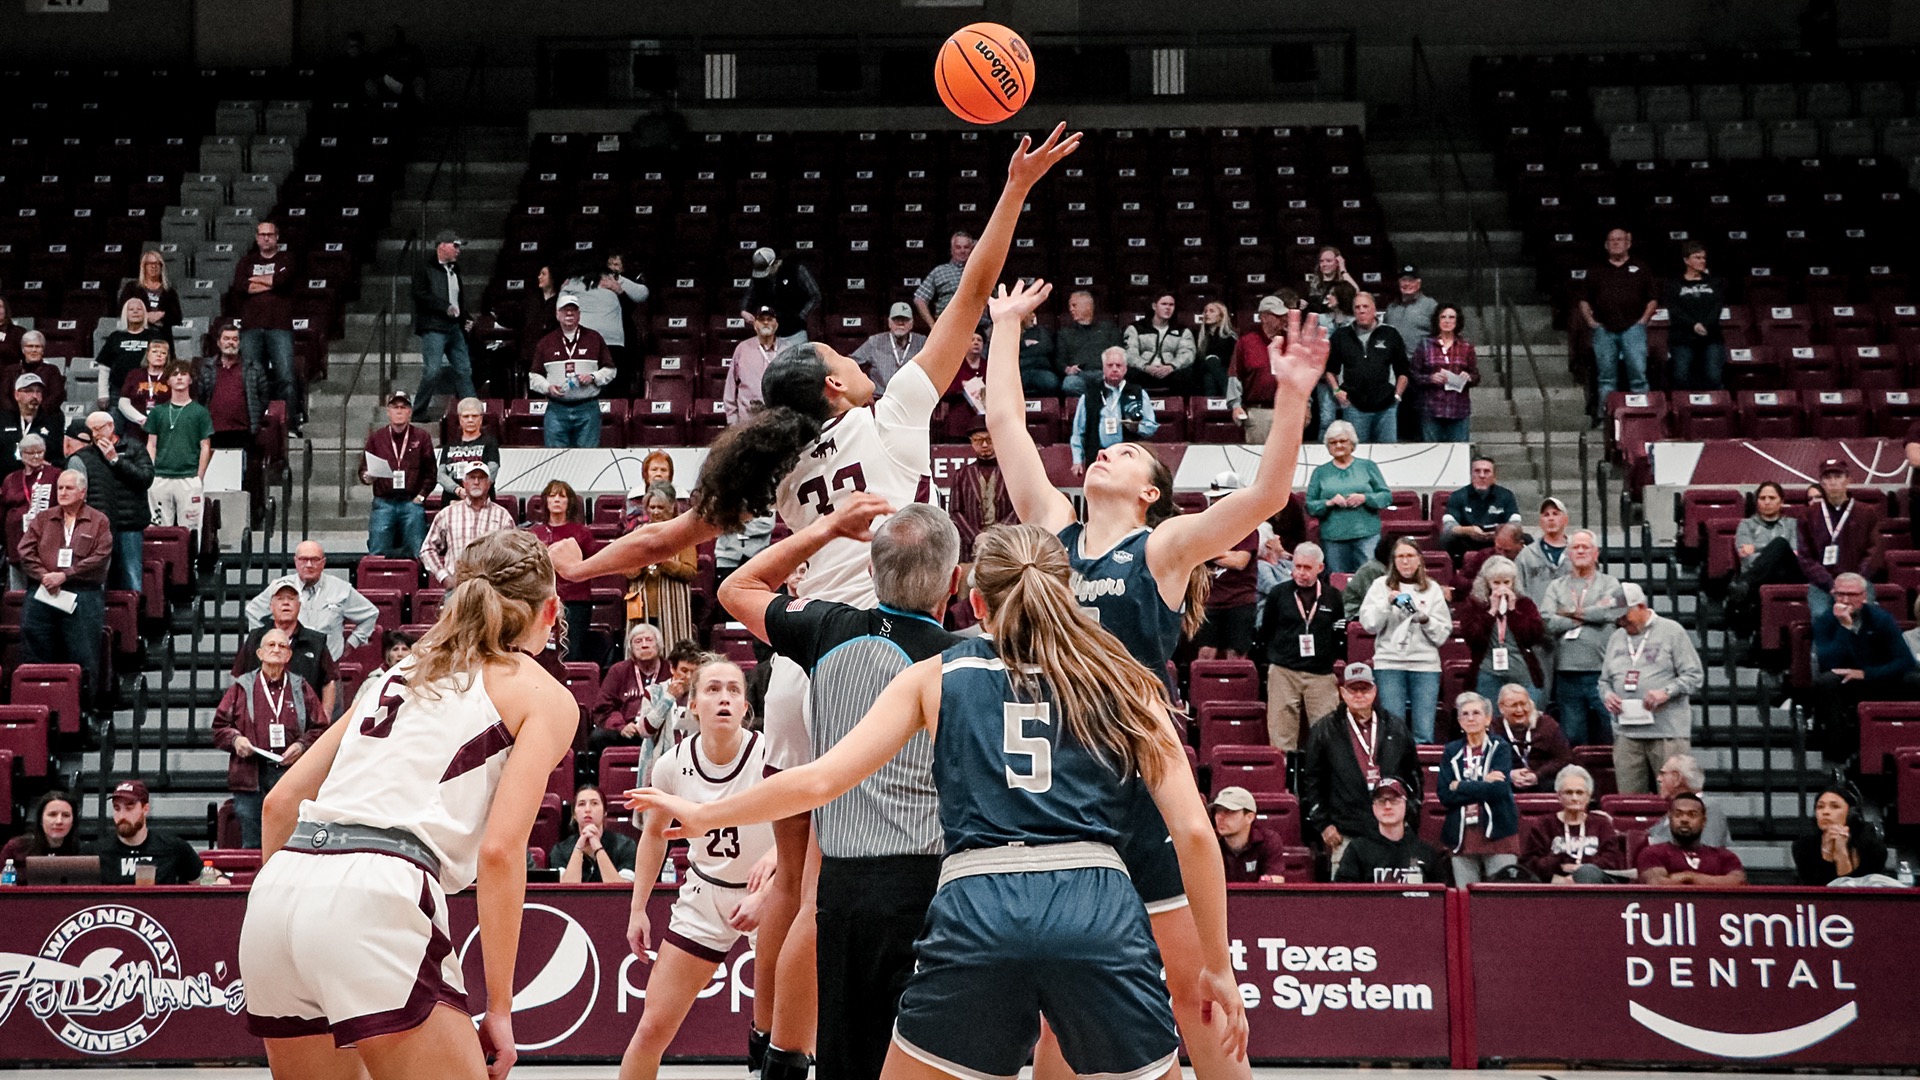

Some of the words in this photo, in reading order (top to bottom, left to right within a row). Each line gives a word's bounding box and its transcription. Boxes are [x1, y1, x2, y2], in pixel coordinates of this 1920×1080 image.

[975, 40, 1019, 100] Wilson
[359, 674, 408, 739] 5
[1003, 701, 1052, 793] 5
[704, 826, 740, 859] 23
[138, 916, 177, 974] WAY
[1620, 902, 1696, 946] full
[1719, 903, 1855, 948] smile
[1257, 937, 1378, 972] Texas
[1626, 956, 1857, 989] DENTAL
[1272, 974, 1433, 1016] System
[60, 1022, 147, 1051] DINER
